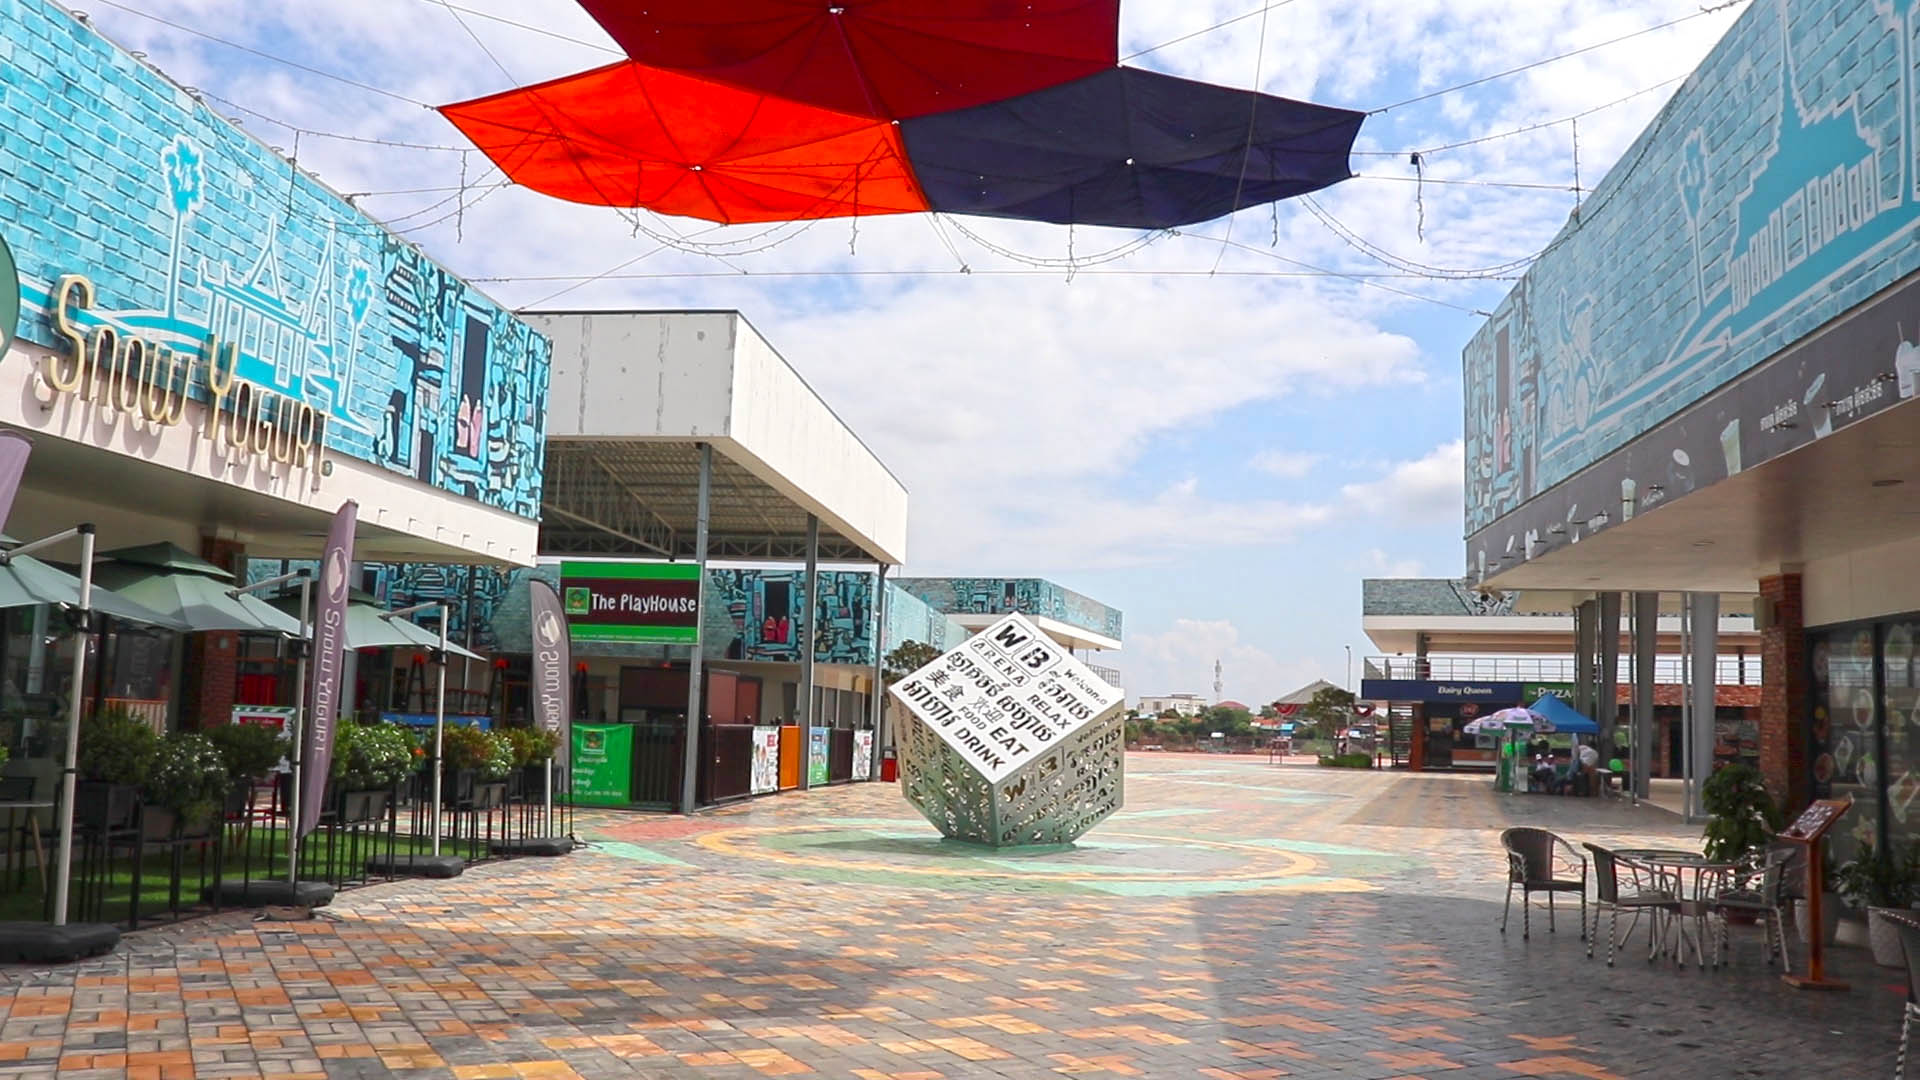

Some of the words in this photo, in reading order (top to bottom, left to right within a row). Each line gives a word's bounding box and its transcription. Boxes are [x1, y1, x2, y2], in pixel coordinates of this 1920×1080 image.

[44, 275, 192, 426] Snow
[591, 593, 616, 610] The
[620, 593, 697, 614] PlayHouse
[995, 624, 1027, 649] W
[974, 641, 1026, 685] ARENA
[1438, 686, 1463, 696] Dairy
[1463, 686, 1493, 696] Queen
[958, 705, 987, 730] FOOD
[1026, 694, 1072, 729] RELAX
[953, 727, 1006, 770] DRINK
[989, 727, 1030, 757] EAT
